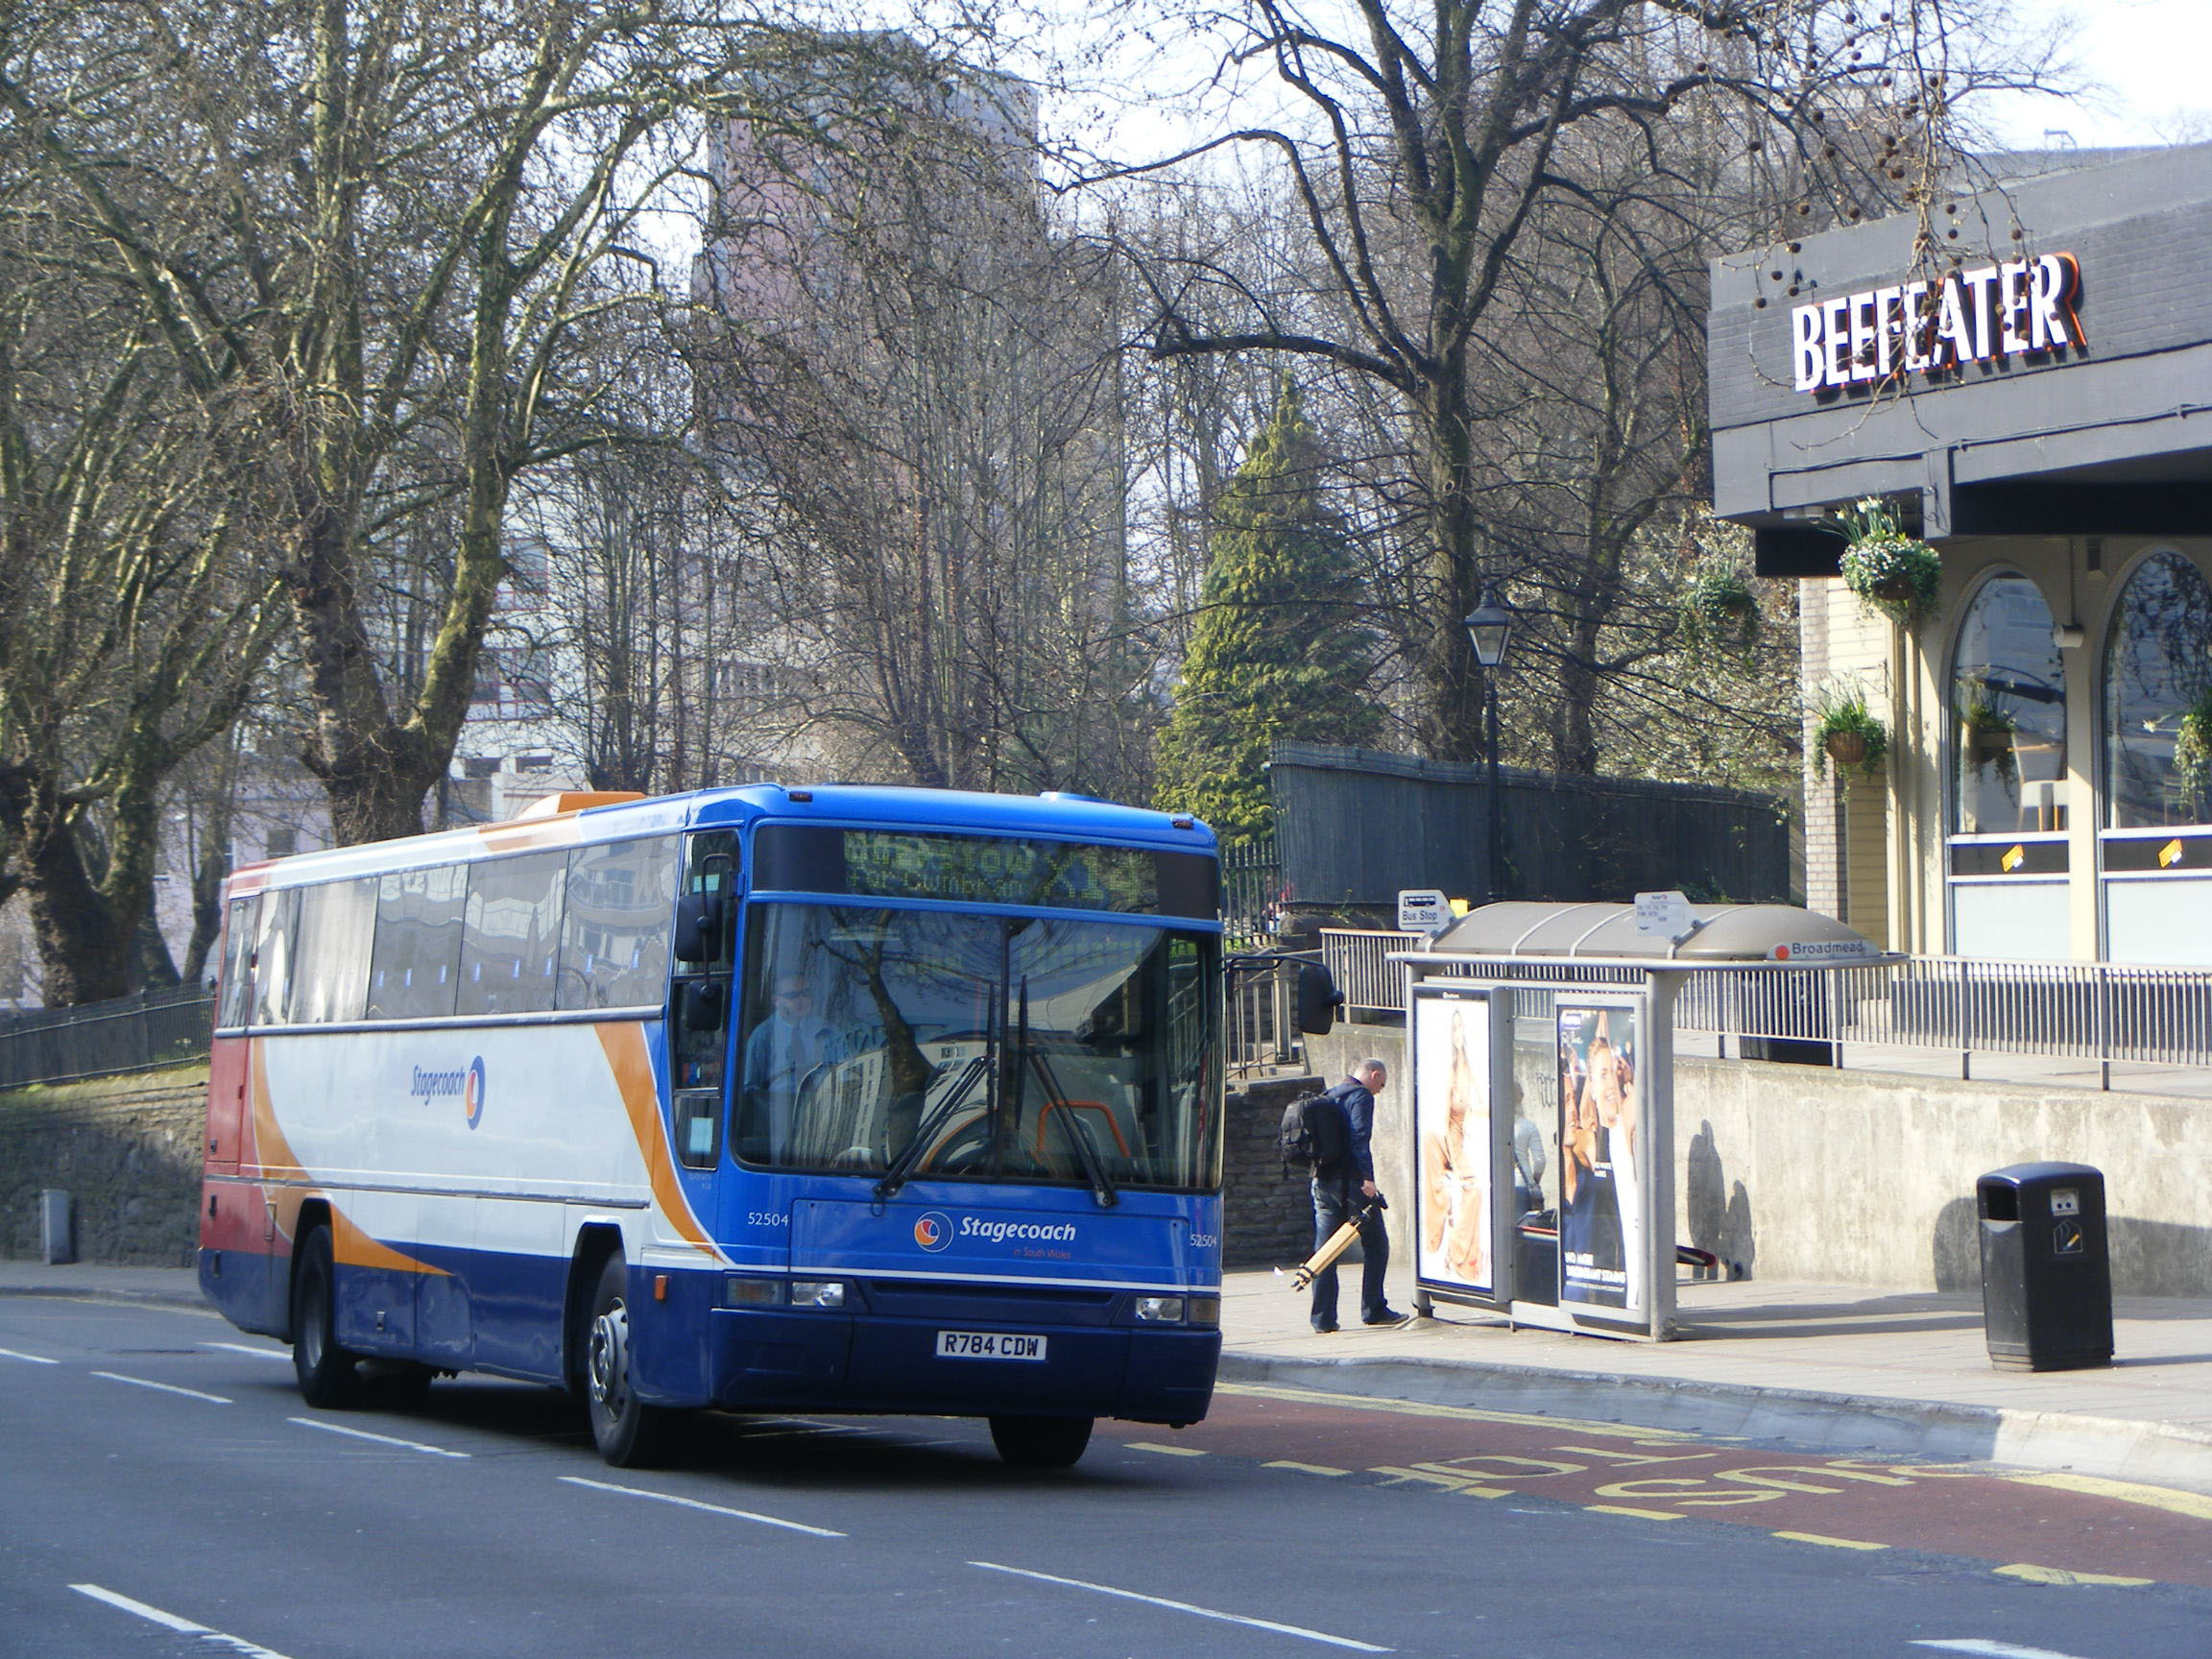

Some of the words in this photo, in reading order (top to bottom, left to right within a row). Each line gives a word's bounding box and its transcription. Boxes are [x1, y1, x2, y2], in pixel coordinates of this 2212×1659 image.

[1792, 252, 2081, 392] BEEFEATER
[1044, 850, 1141, 902] X14
[1402, 910, 1417, 921] Bus
[1419, 909, 1437, 922] Stop
[1791, 941, 1864, 955] Broadmead
[411, 1065, 466, 1106] Stagecoach
[748, 1212, 789, 1226] 52504
[959, 1216, 1076, 1242] Stagecoach
[1190, 1234, 1217, 1247] 52504
[945, 1334, 995, 1355] R784
[1000, 1336, 1039, 1357] CDW
